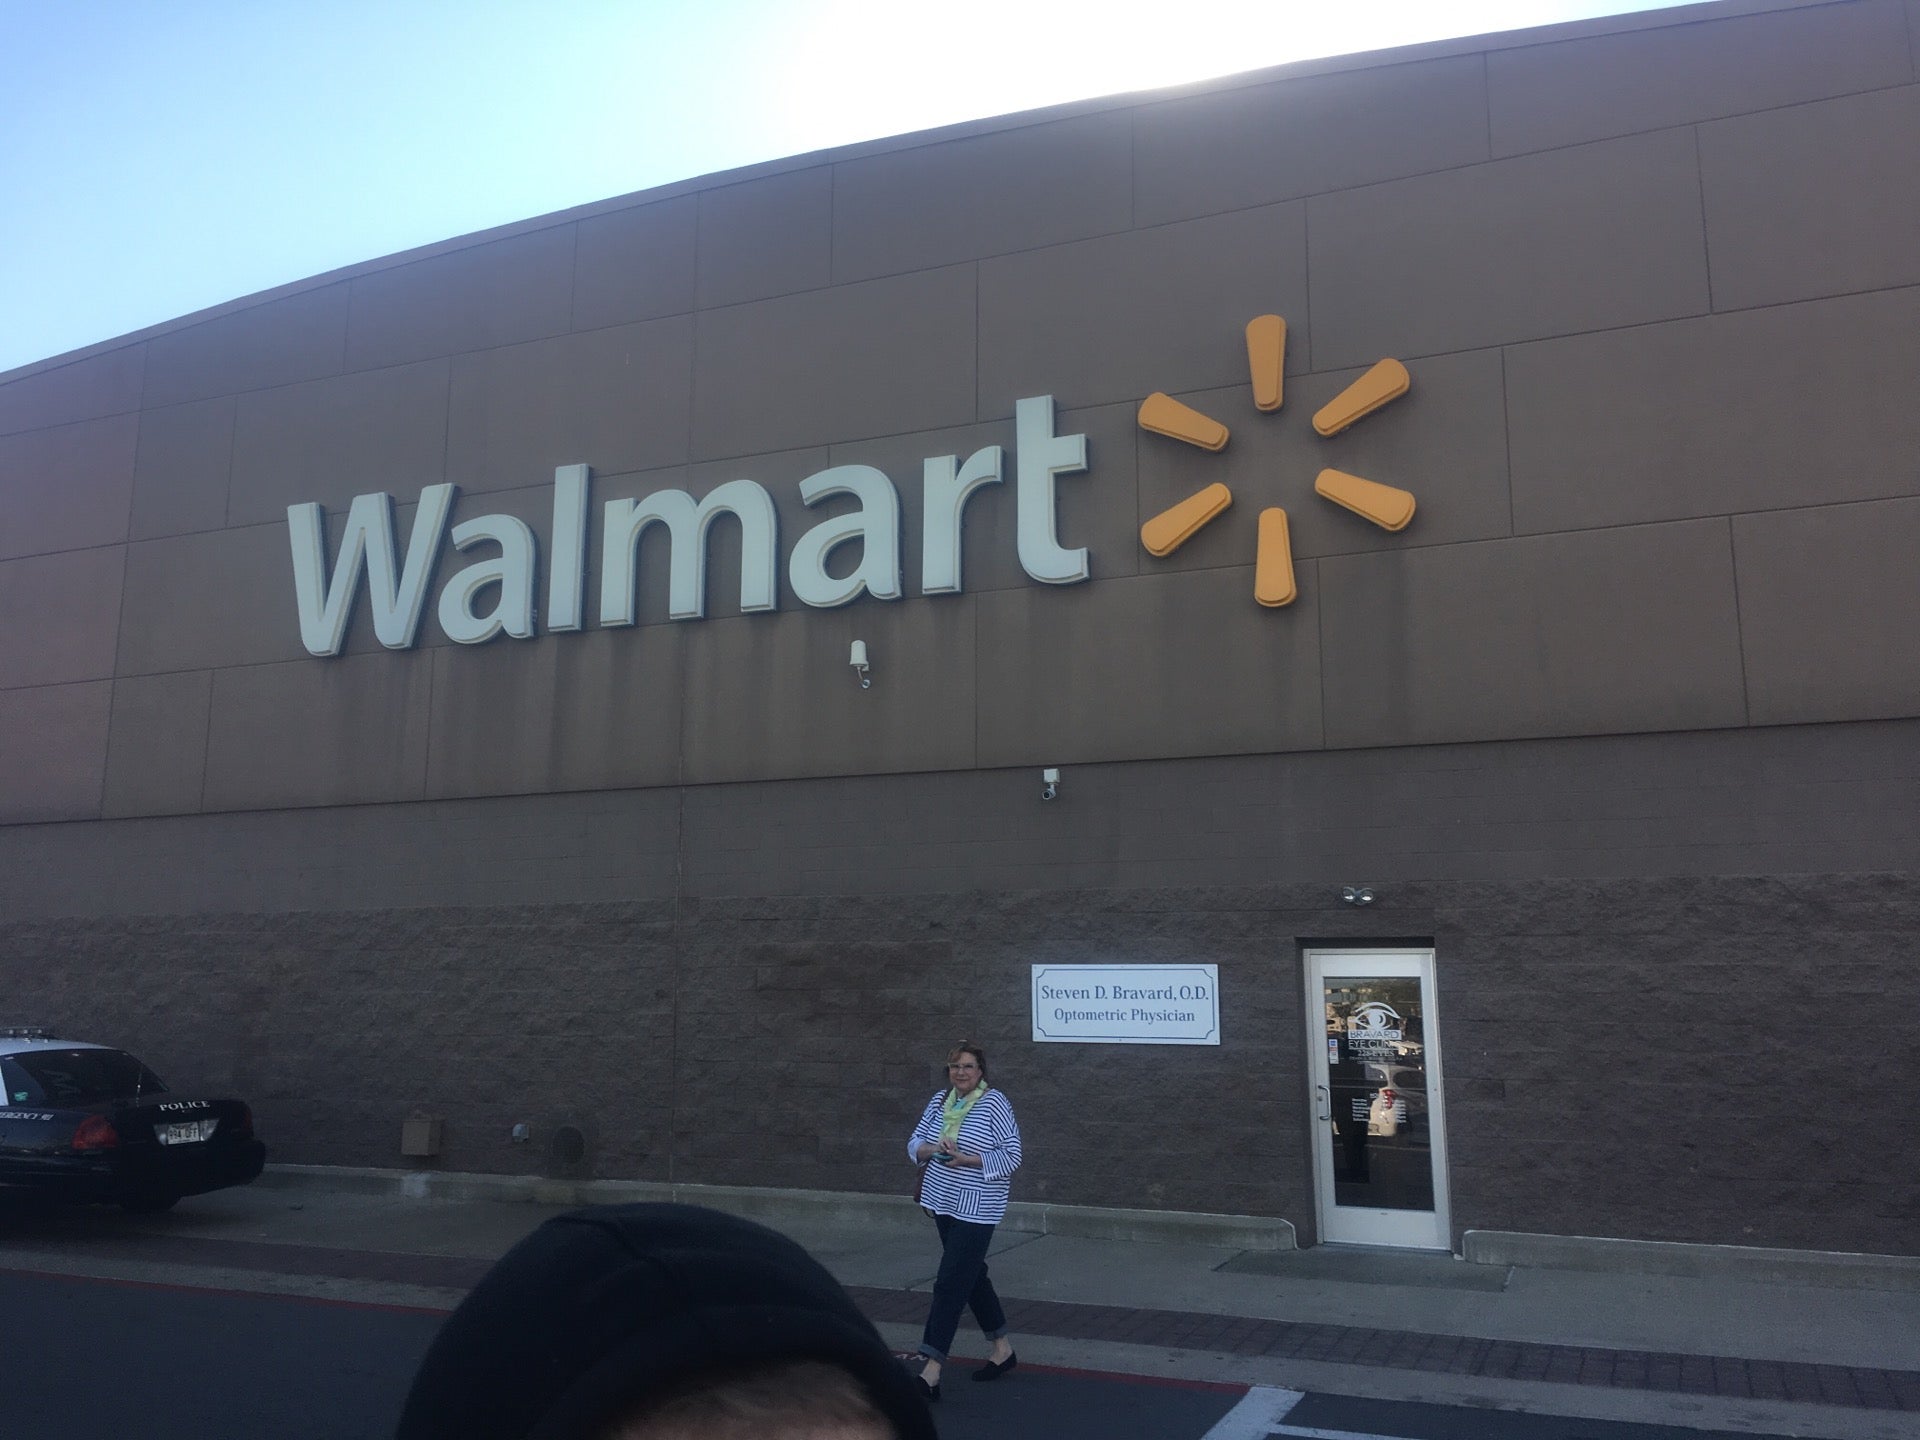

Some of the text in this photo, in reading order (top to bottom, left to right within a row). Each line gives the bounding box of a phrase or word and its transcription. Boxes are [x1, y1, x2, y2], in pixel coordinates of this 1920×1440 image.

[287, 394, 1091, 658] Walmart
[1041, 985, 1209, 1002] Steven D. Bravard, O.D.
[1054, 1007, 1196, 1025] Optometric Physician
[1350, 1030, 1399, 1039] BRAVARD
[1348, 1040, 1366, 1049] EYE
[160, 1100, 211, 1111] POLICE
